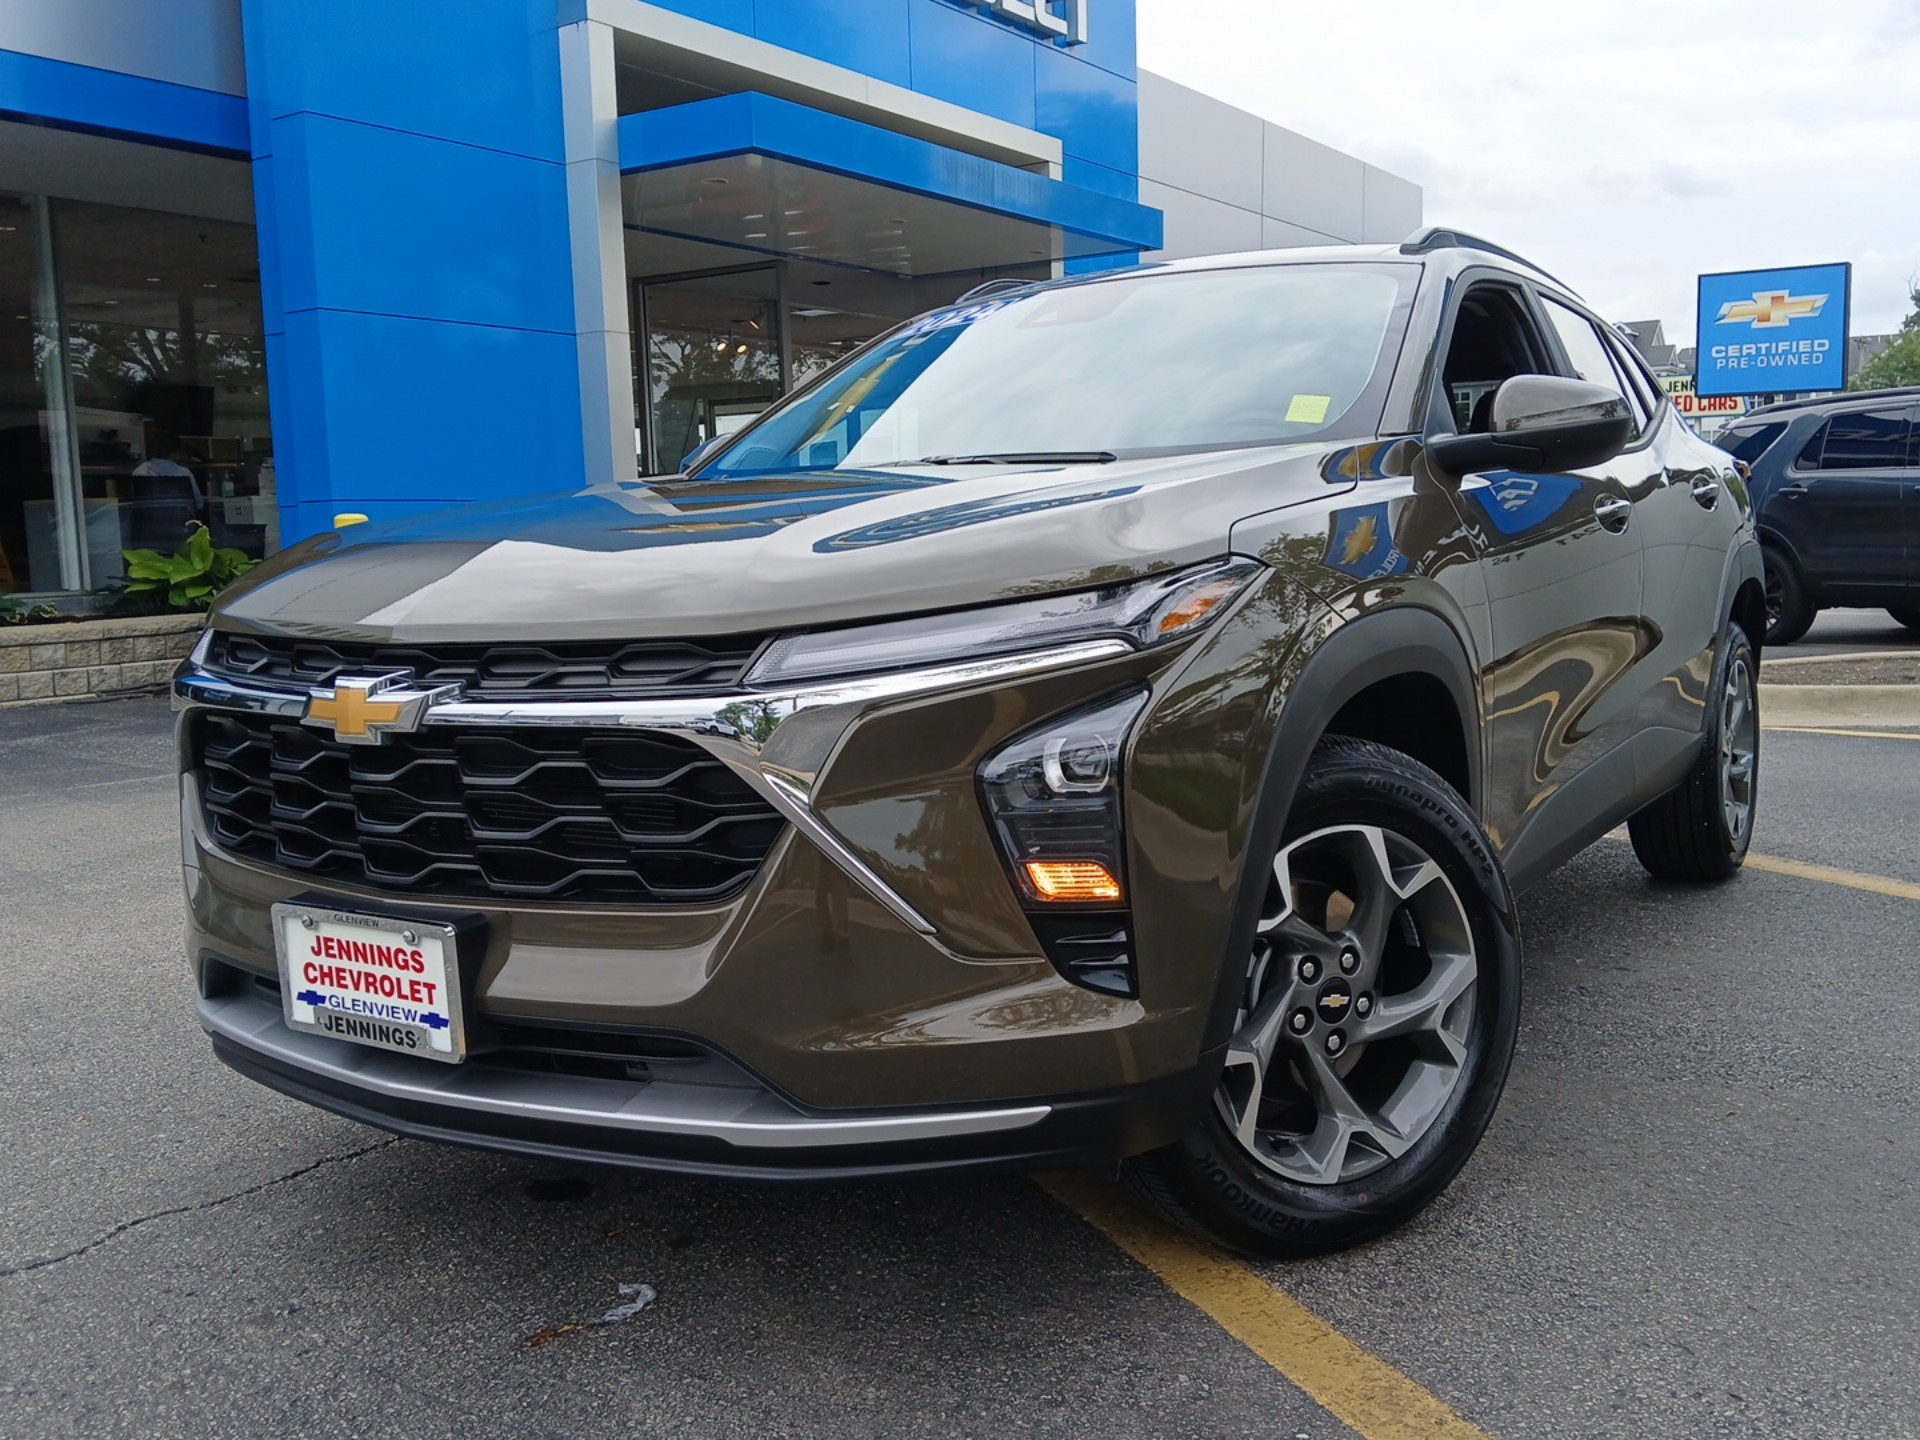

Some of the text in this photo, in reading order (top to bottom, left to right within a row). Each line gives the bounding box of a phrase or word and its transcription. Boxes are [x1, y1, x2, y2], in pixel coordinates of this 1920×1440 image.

[1711, 339, 1830, 358] CERTIFIED
[1716, 353, 1824, 370] PRE-OWNED
[1672, 394, 1738, 413] ED CARS
[333, 914, 380, 928] GLENVIEW
[311, 935, 425, 974] JENNINGS
[303, 962, 437, 1006] CHEVROLET
[328, 994, 418, 1023] GLENVIEW
[324, 1014, 417, 1049] JENNINGS
